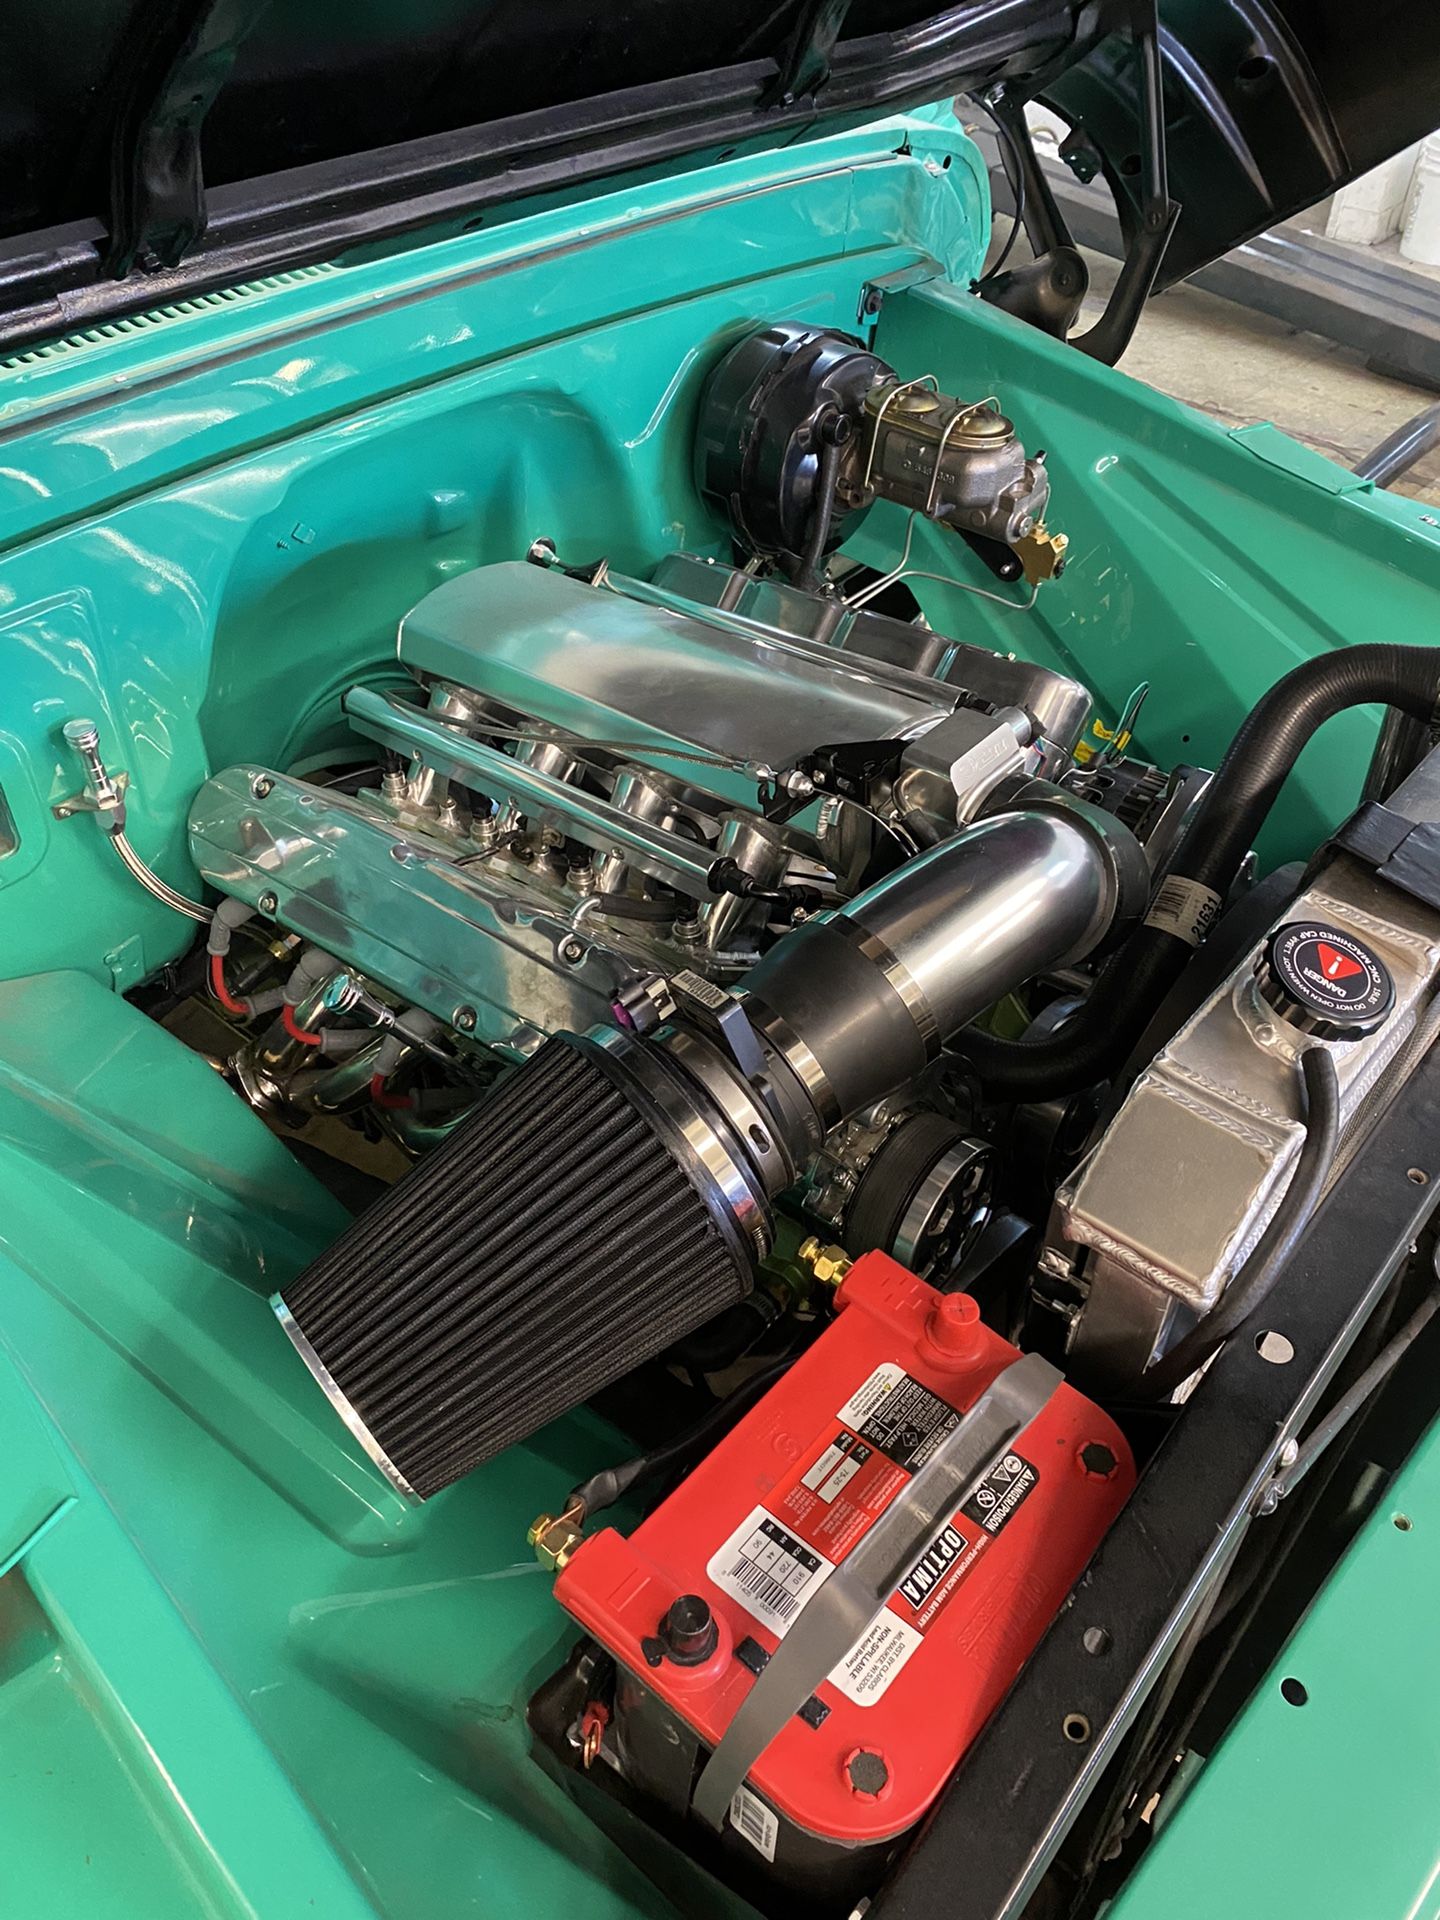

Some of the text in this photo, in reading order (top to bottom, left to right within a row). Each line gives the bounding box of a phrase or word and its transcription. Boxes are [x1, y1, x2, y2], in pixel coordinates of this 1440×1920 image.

[1190, 896, 1217, 940] 21631
[1300, 931, 1381, 984] CNC MACHINED CAP
[1290, 972, 1309, 995] WHEN
[1303, 967, 1347, 997] DANGER
[1310, 993, 1334, 1008] OPEN
[861, 1388, 887, 1418] WARNING:
[904, 1383, 918, 1399] REACH
[921, 1392, 932, 1405] GET
[905, 1402, 925, 1424] MEDICAL
[915, 1400, 943, 1432] IMMEDIATELY
[869, 1426, 881, 1438] NOT
[875, 1431, 885, 1441] DO
[895, 1421, 909, 1436] HELP
[922, 1419, 936, 1434] EYES
[832, 1468, 850, 1487] 75-25
[985, 1477, 1030, 1532] DANGER/POISON
[752, 1523, 775, 1549] RC 90
[766, 1534, 789, 1561] AH 44
[778, 1546, 802, 1574] CCA 720
[792, 1557, 817, 1585] CA 910
[901, 1528, 964, 1602] OPTIMA
[944, 1534, 989, 1591] HIGH-PERFORMANCE
[935, 1587, 949, 1604] AGM
[915, 1600, 940, 1629] BATTERY
[844, 1625, 882, 1669] Lead Acid Battery
[849, 1626, 892, 1680] NON-SPILLABLE
[870, 1664, 879, 1674] WI
[885, 1656, 895, 1666] BY
[855, 1672, 874, 1694] 53209
[867, 1664, 890, 1691] CLARIOS
